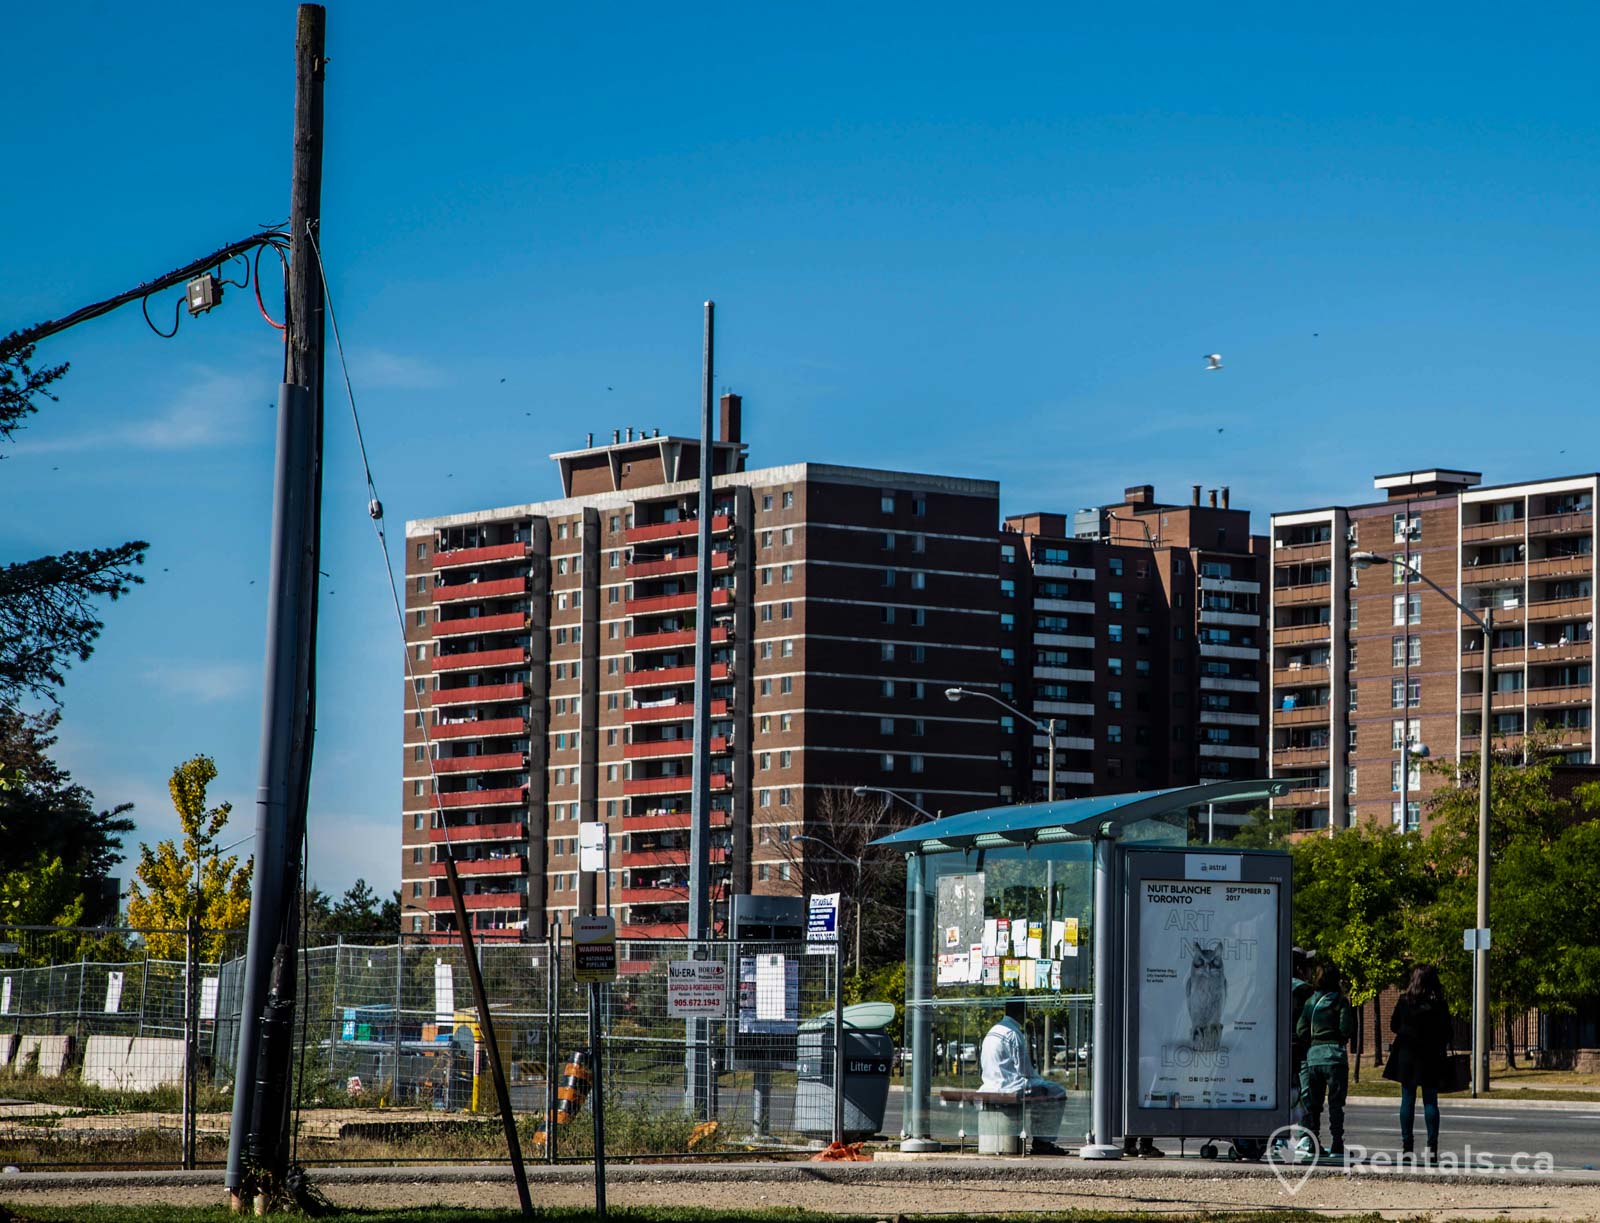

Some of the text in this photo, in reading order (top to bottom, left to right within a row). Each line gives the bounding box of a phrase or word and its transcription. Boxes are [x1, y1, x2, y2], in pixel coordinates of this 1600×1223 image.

[1208, 863, 1227, 871] astral
[1147, 884, 1212, 895] NUIT BLANCHE
[1225, 887, 1262, 895] SEPTEMBER
[1147, 894, 1193, 904] TORONTO
[1164, 908, 1214, 932] ART
[578, 945, 613, 953] WARNING
[673, 998, 721, 1007] 905.672.1943
[1160, 1045, 1230, 1069] LONG
[850, 1061, 872, 1072] Litter
